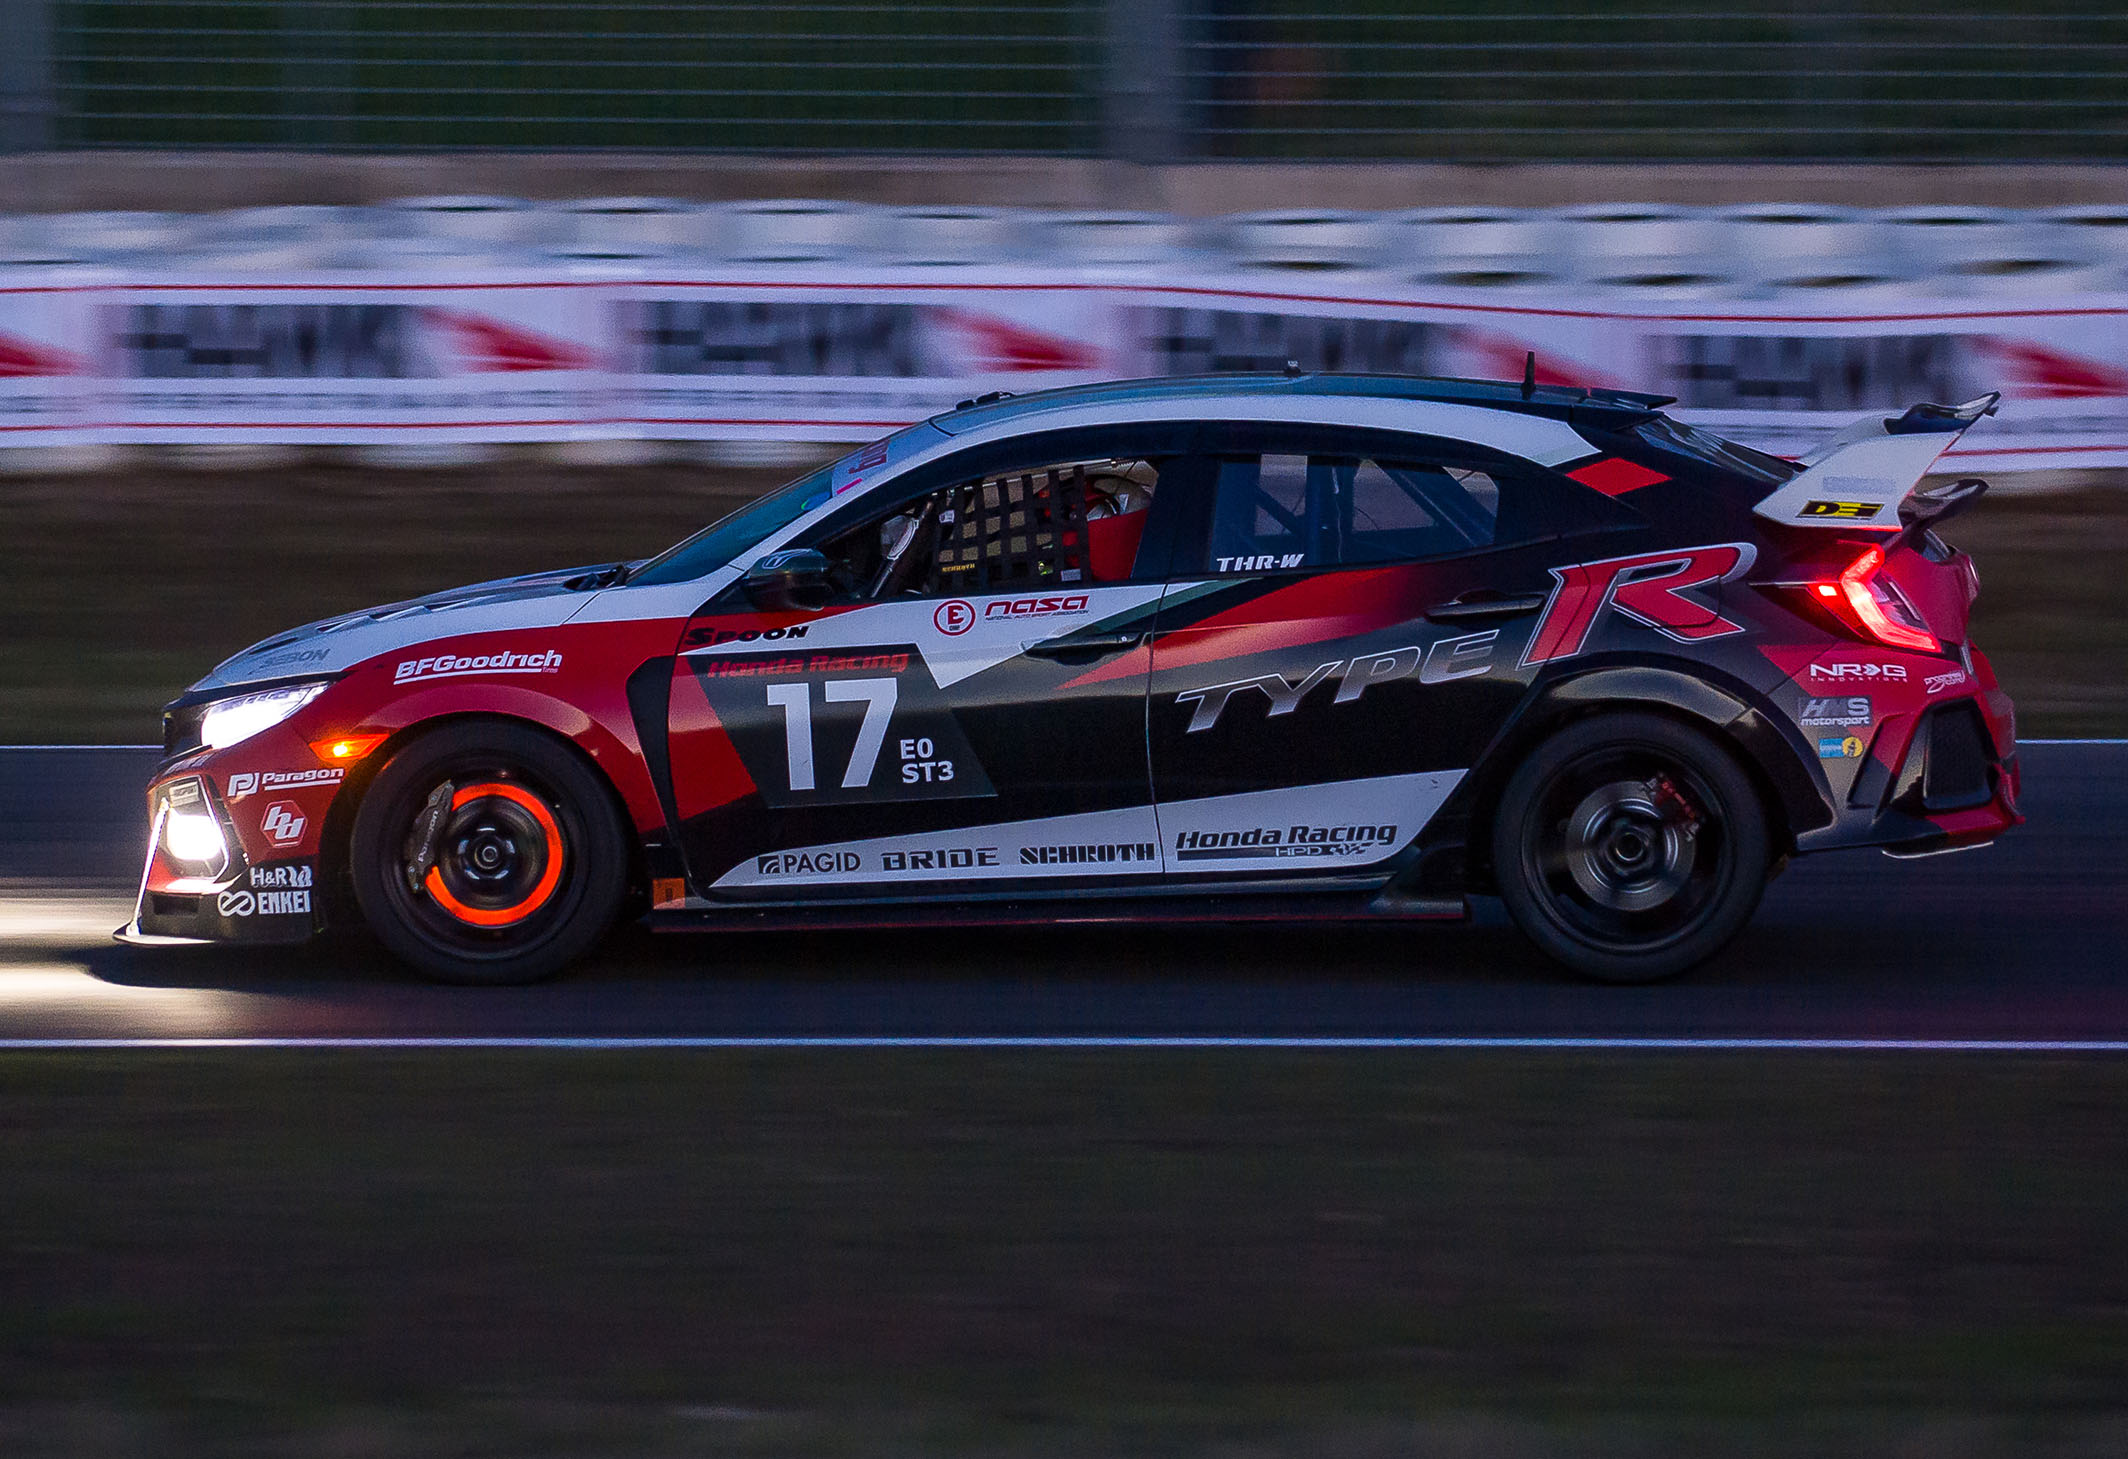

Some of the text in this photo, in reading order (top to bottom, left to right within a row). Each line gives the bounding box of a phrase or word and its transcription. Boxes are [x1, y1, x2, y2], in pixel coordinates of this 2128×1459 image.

[1216, 553, 1305, 572] THR-W
[1175, 542, 1757, 734] TYPE R
[394, 649, 563, 679] BFGoodrich
[707, 652, 910, 679] Honda Racing
[766, 677, 898, 791] 17
[1800, 716, 1871, 728] motorsport
[261, 768, 344, 785] Paragon
[901, 761, 954, 784] ST3
[1176, 825, 1397, 849] Honda Racing
[784, 843, 1155, 873] PAGID BRIDE SCHROTH
[250, 867, 288, 887] H&R
[257, 891, 312, 915] ENKEI
